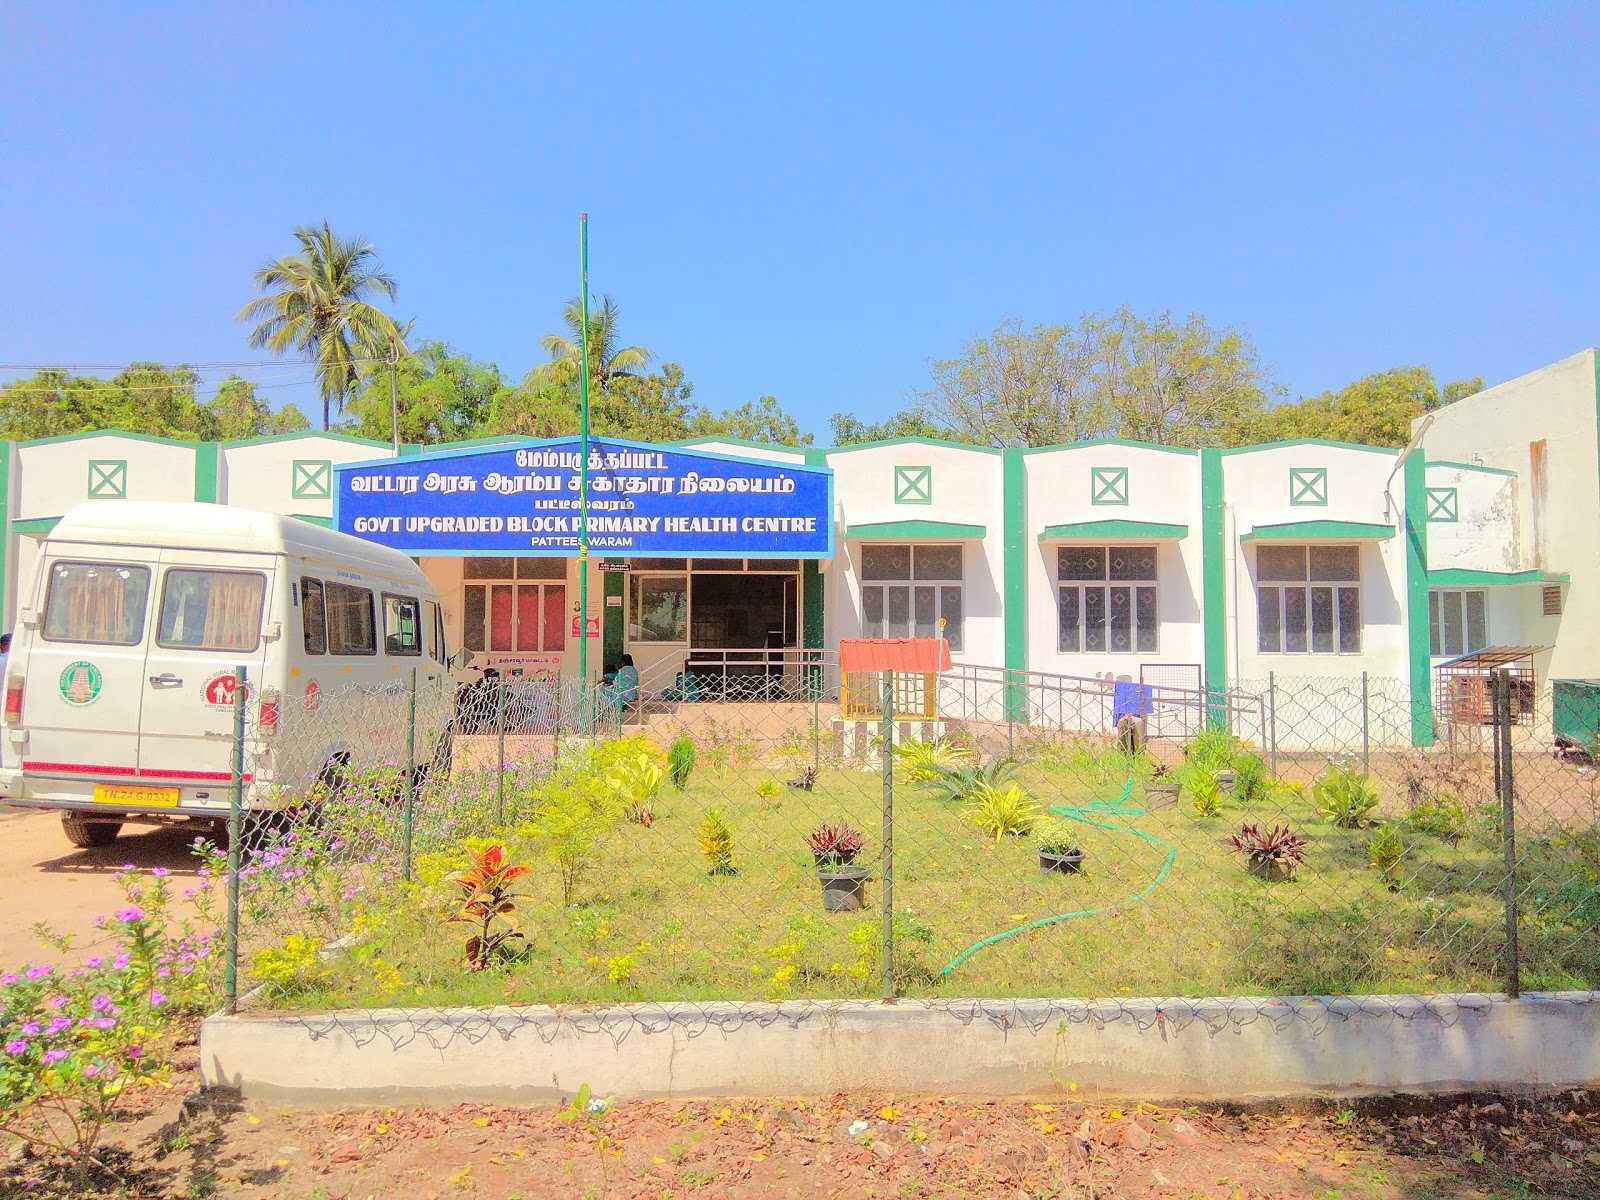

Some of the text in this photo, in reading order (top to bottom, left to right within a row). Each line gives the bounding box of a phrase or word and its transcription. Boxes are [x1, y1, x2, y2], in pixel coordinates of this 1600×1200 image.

[351, 475, 420, 495] வட்டார
[423, 472, 478, 495] அரசு
[483, 471, 562, 495] ஆரம்ப
[676, 471, 795, 495] நிலையம்
[353, 516, 817, 533] GOVT UPGRADED BLOCK PRIMARY HEALTH CENTRE
